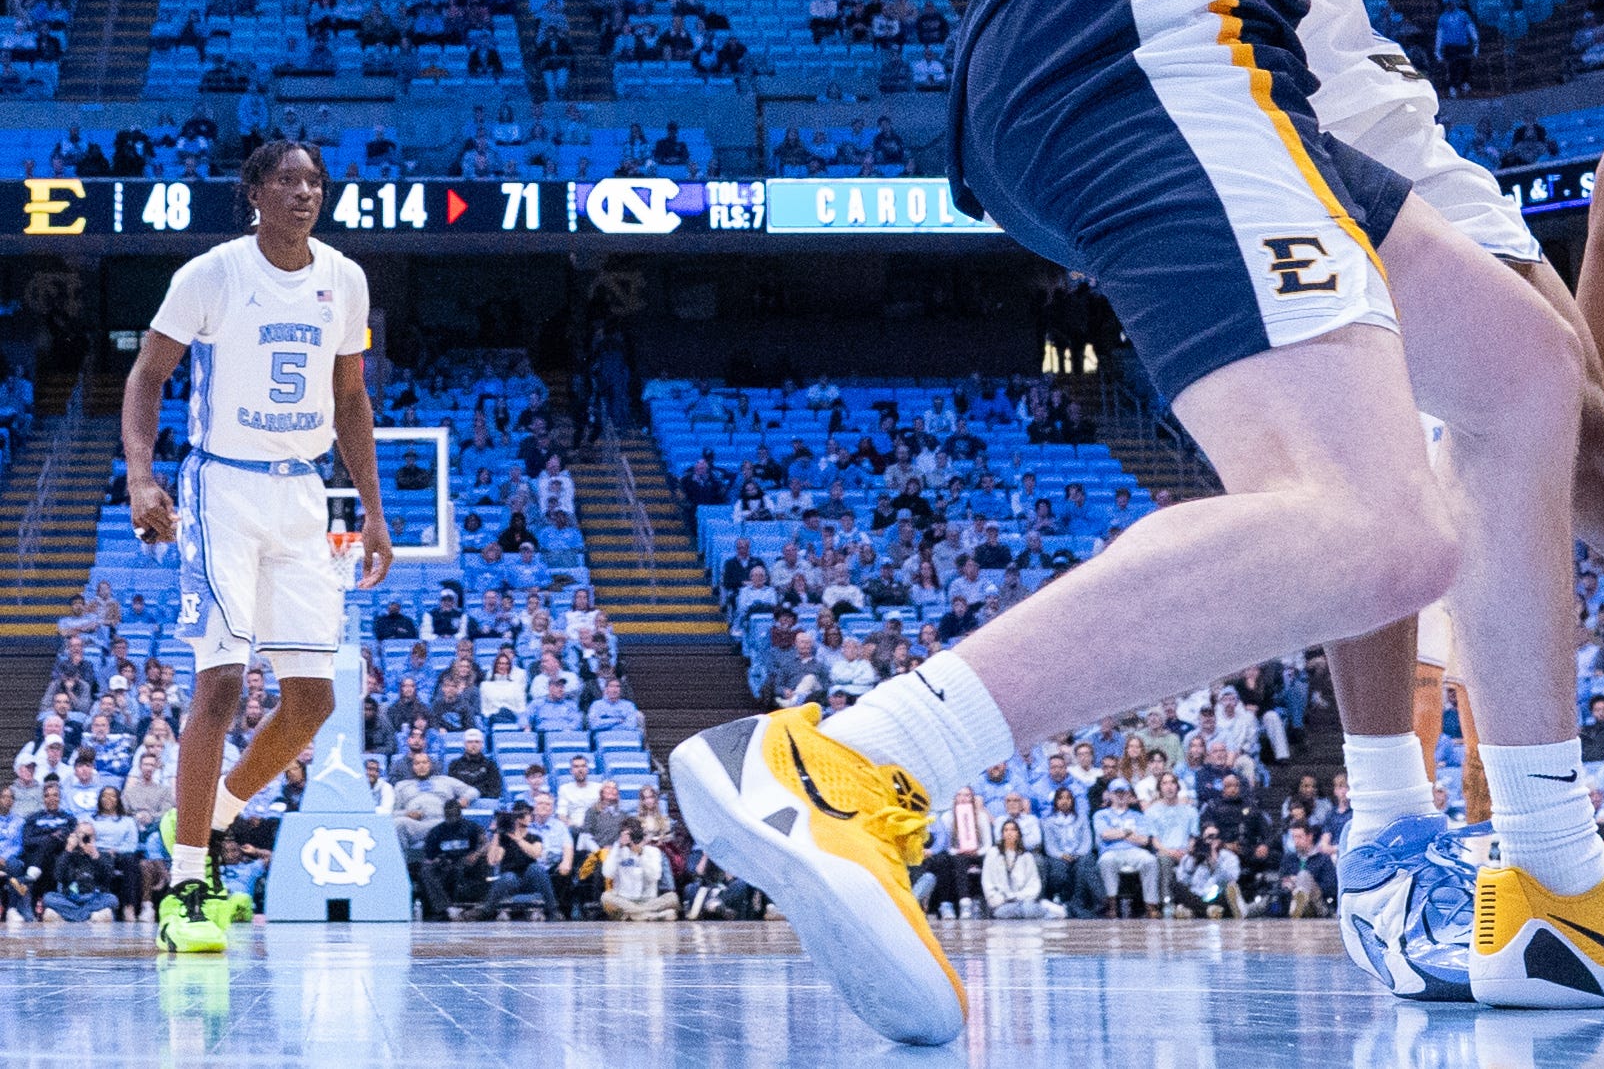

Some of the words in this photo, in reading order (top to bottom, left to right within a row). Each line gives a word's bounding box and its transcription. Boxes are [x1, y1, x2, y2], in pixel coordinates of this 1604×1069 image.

[23, 178, 87, 235] E
[142, 182, 191, 230] 48
[333, 182, 428, 230] 4:14
[501, 182, 541, 230] 71
[752, 205, 765, 229] 7
[816, 187, 980, 223] CAROL
[259, 322, 322, 347] NORTH
[269, 352, 307, 404] 5
